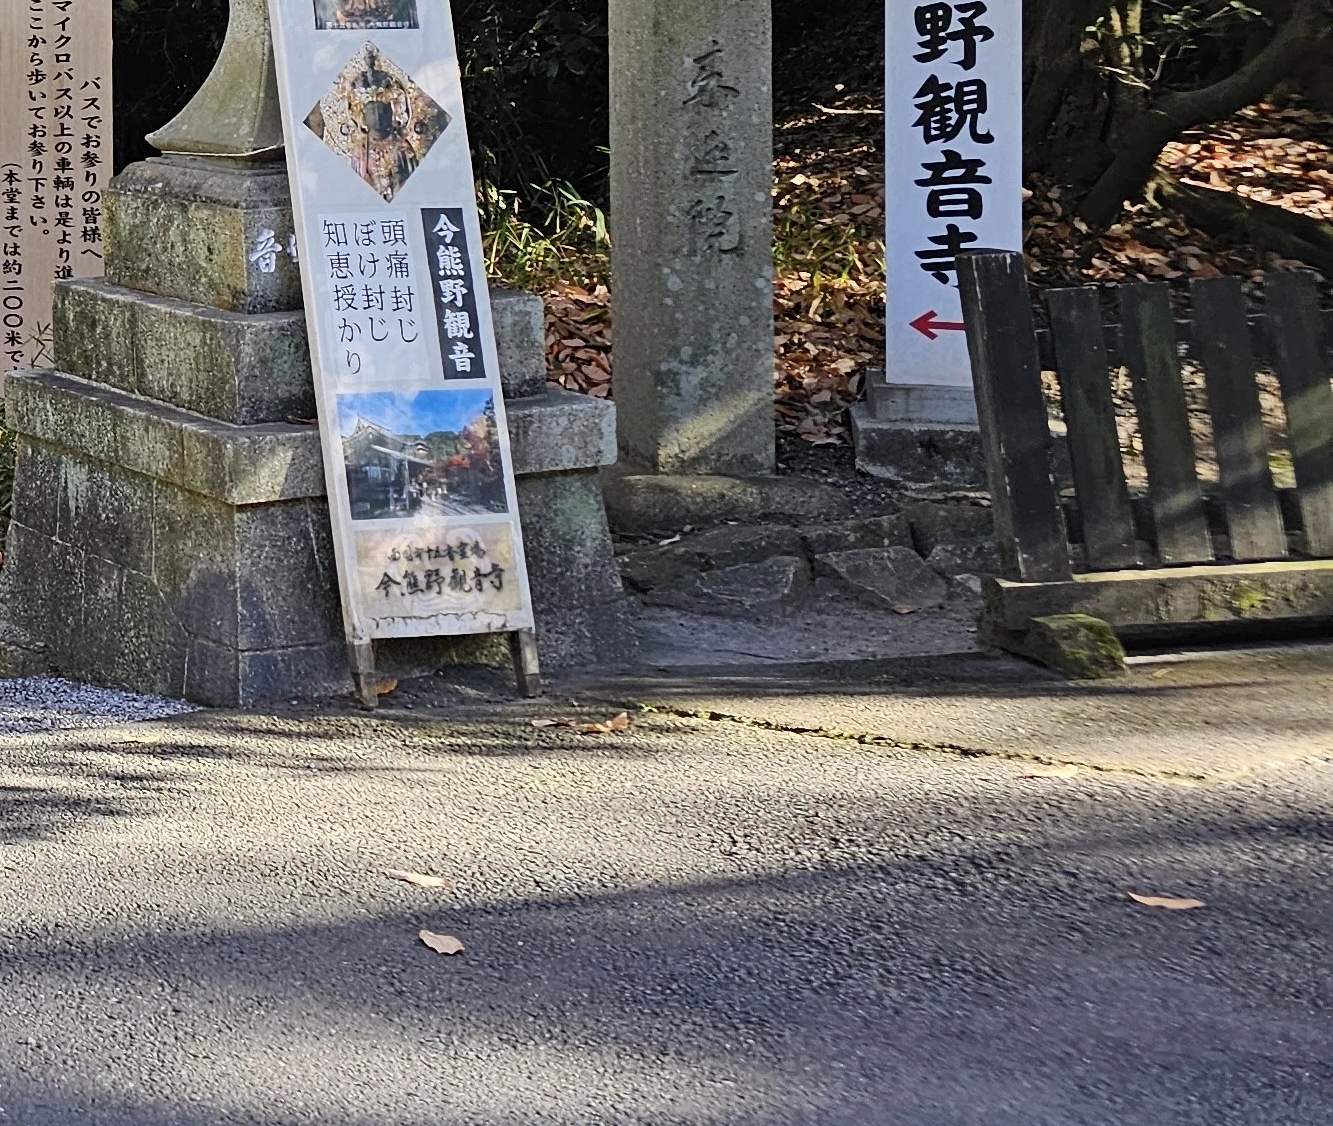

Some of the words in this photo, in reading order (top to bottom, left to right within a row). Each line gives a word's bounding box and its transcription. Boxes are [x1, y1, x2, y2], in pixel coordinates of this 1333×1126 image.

[26, 0, 50, 237] ここから歩いてお参り下さい。
[80, 76, 103, 260] バスでお参りの皆様へ
[1, 162, 25, 373] （本堂までは約二〇〇米で
[322, 219, 363, 376] 知恵授かり
[352, 218, 389, 344] ぼけ封じ
[381, 218, 419, 344] 頭痛封じ
[432, 213, 476, 374] 今熊野観音
